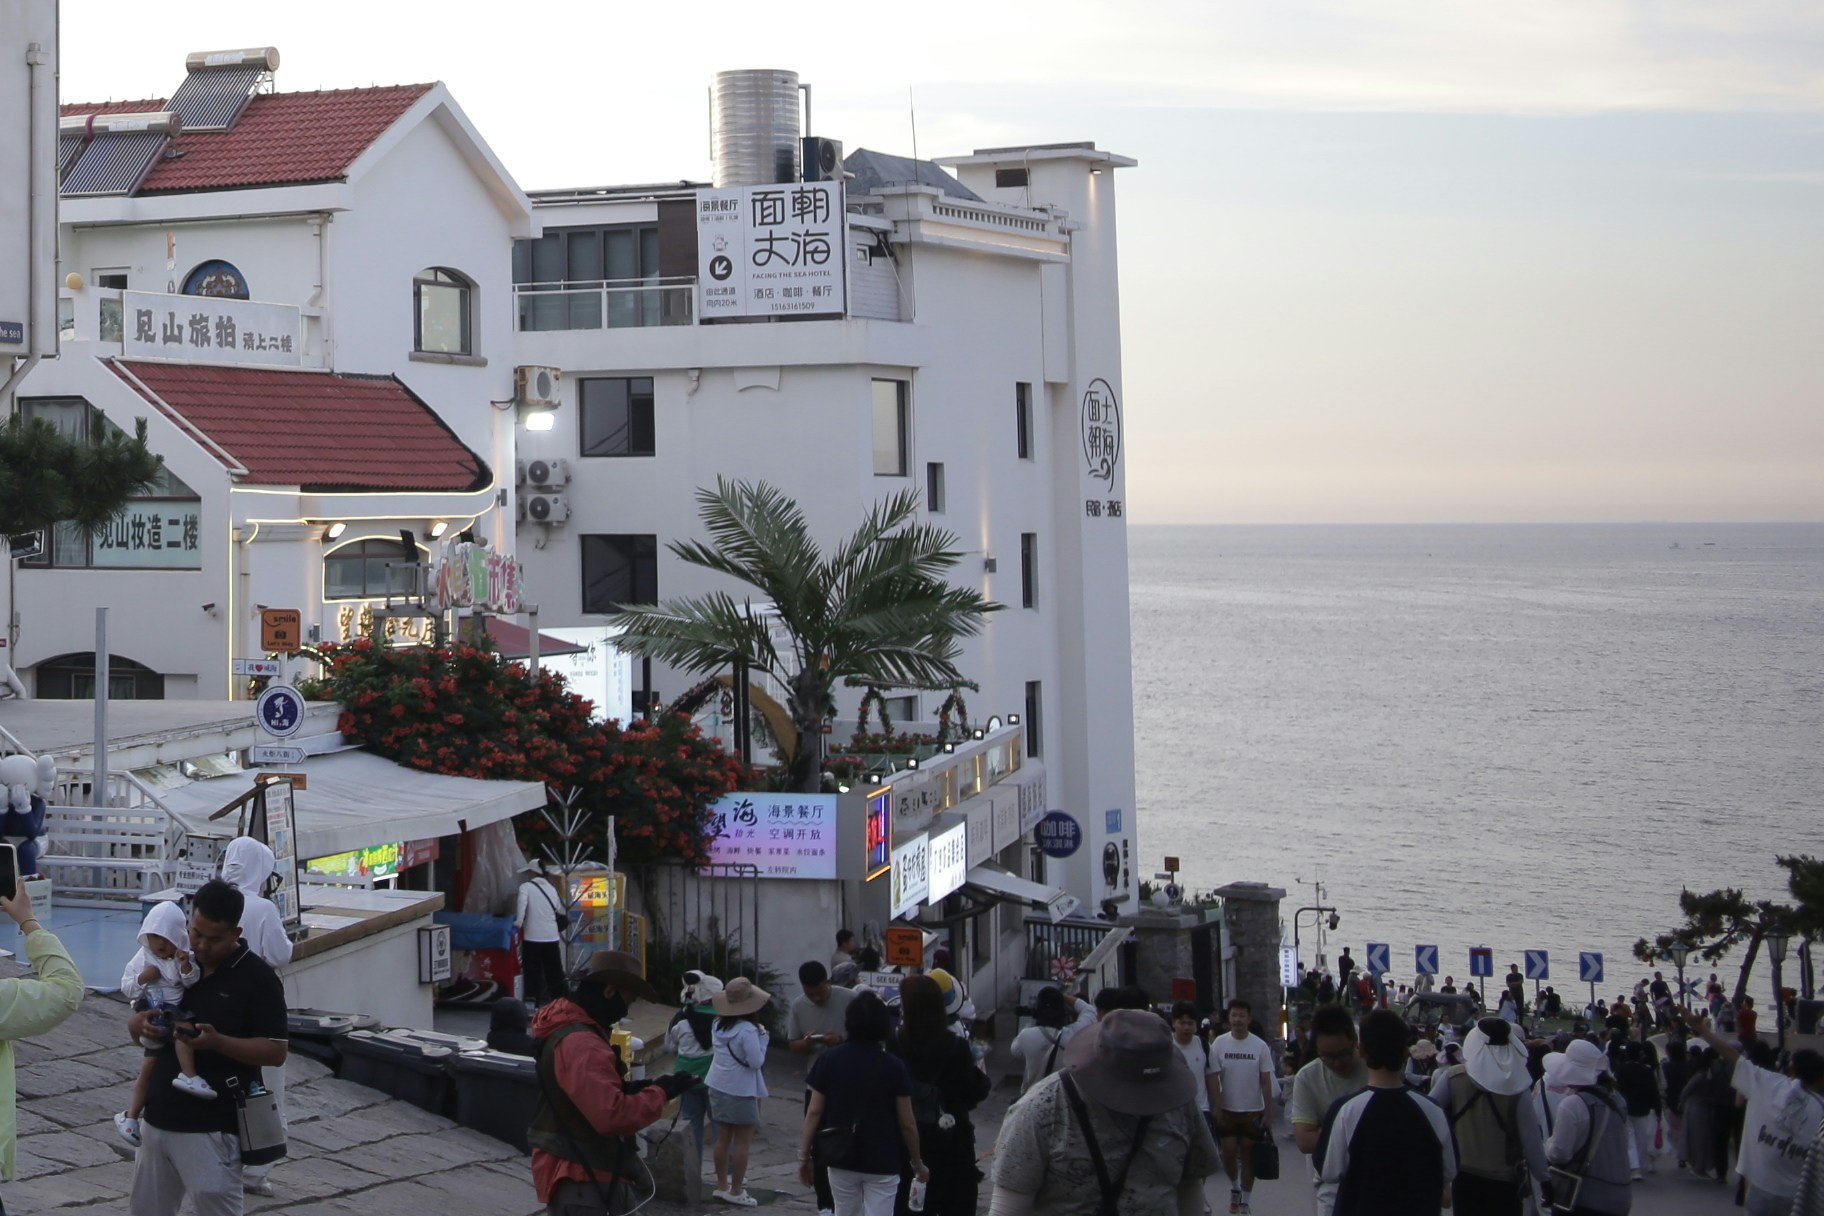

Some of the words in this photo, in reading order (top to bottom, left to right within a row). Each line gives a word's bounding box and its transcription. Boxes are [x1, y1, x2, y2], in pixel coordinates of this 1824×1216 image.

[700, 199, 738, 213] 海景餐厅
[751, 186, 830, 228] 面朝
[752, 229, 831, 267] 大海
[753, 287, 775, 300] 酒店
[782, 286, 804, 298] 咖啡
[812, 285, 832, 297] 餐厅
[9, 329, 22, 339] sea
[134, 309, 237, 350] 见山旅拍
[242, 332, 294, 353] 请上二楼
[99, 513, 198, 551] 见山妆造二楼
[273, 614, 297, 624] smile
[767, 804, 825, 819] 海景餐厅
[768, 827, 822, 841] 空调开放
[1040, 819, 1076, 838] 咖啡
[767, 865, 798, 875] 左转院内
